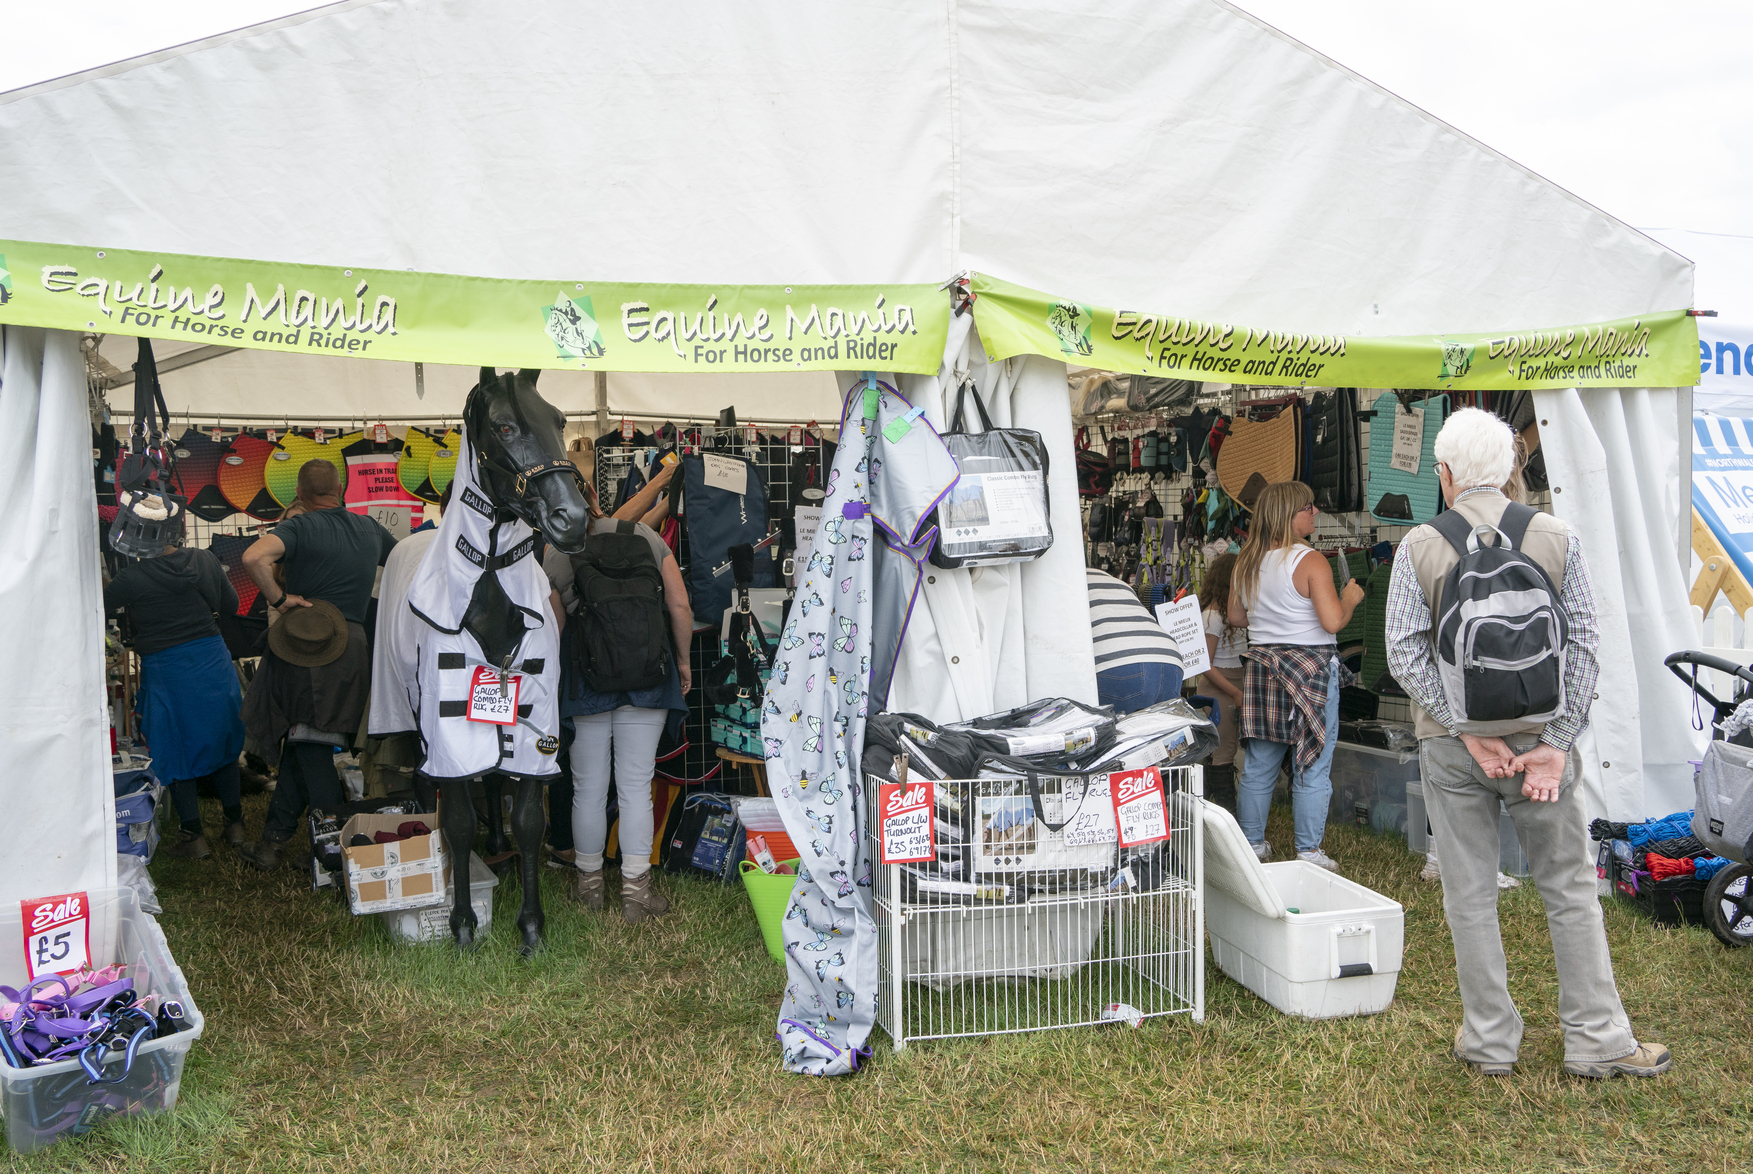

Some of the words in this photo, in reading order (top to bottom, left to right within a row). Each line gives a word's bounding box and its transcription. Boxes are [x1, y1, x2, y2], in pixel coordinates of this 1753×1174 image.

[41, 263, 226, 319] Equine
[240, 279, 399, 336] Mania
[120, 306, 164, 329] For
[171, 315, 245, 340] Horse
[252, 328, 301, 347] and
[307, 330, 372, 352] Rider
[621, 293, 773, 359] Equine
[785, 293, 918, 340] Mania
[1111, 308, 1234, 363] Equine
[694, 344, 727, 364] For
[734, 343, 793, 363] Horse
[801, 342, 838, 361] and
[846, 337, 898, 361] Rider
[1481, 330, 1576, 377] Equine
[1578, 319, 1651, 360] Mania
[1158, 347, 1186, 370] For
[1190, 350, 1238, 374] Horse
[1242, 357, 1274, 376] and
[1278, 356, 1324, 379] Rider
[1518, 360, 1541, 380] For
[1541, 360, 1574, 380] Horse
[1578, 361, 1602, 379] and
[1605, 357, 1637, 379] Rider
[358, 468, 376, 476] HORSE
[464, 491, 492, 515] GALLOP
[375, 510, 399, 527] £10
[457, 538, 482, 563] GALLOP
[512, 540, 534, 561] GALLOP
[1165, 606, 1179, 616] SHOW
[1179, 602, 1193, 611] OFFER
[1169, 623, 1194, 635] HEADCOLLAR
[474, 684, 501, 695] GALLOP
[473, 696, 497, 705] COMBO
[498, 697, 512, 705] FLY
[473, 703, 487, 712] RUG
[490, 705, 509, 713] £27
[538, 740, 558, 749] GALLOP
[1065, 773, 1108, 790] GALOP
[1118, 771, 1155, 799] Sale
[886, 784, 926, 812] Sale
[1121, 803, 1141, 816] GALLOP
[1144, 801, 1164, 811] COMBO
[1126, 813, 1140, 824] FLY
[1143, 810, 1160, 820] RUGS
[884, 825, 923, 837] TURNOUT
[885, 815, 910, 828] GALLOP
[1075, 812, 1100, 832] £27
[887, 839, 907, 854] £35
[31, 896, 82, 929] Sale
[36, 931, 72, 967] £5
